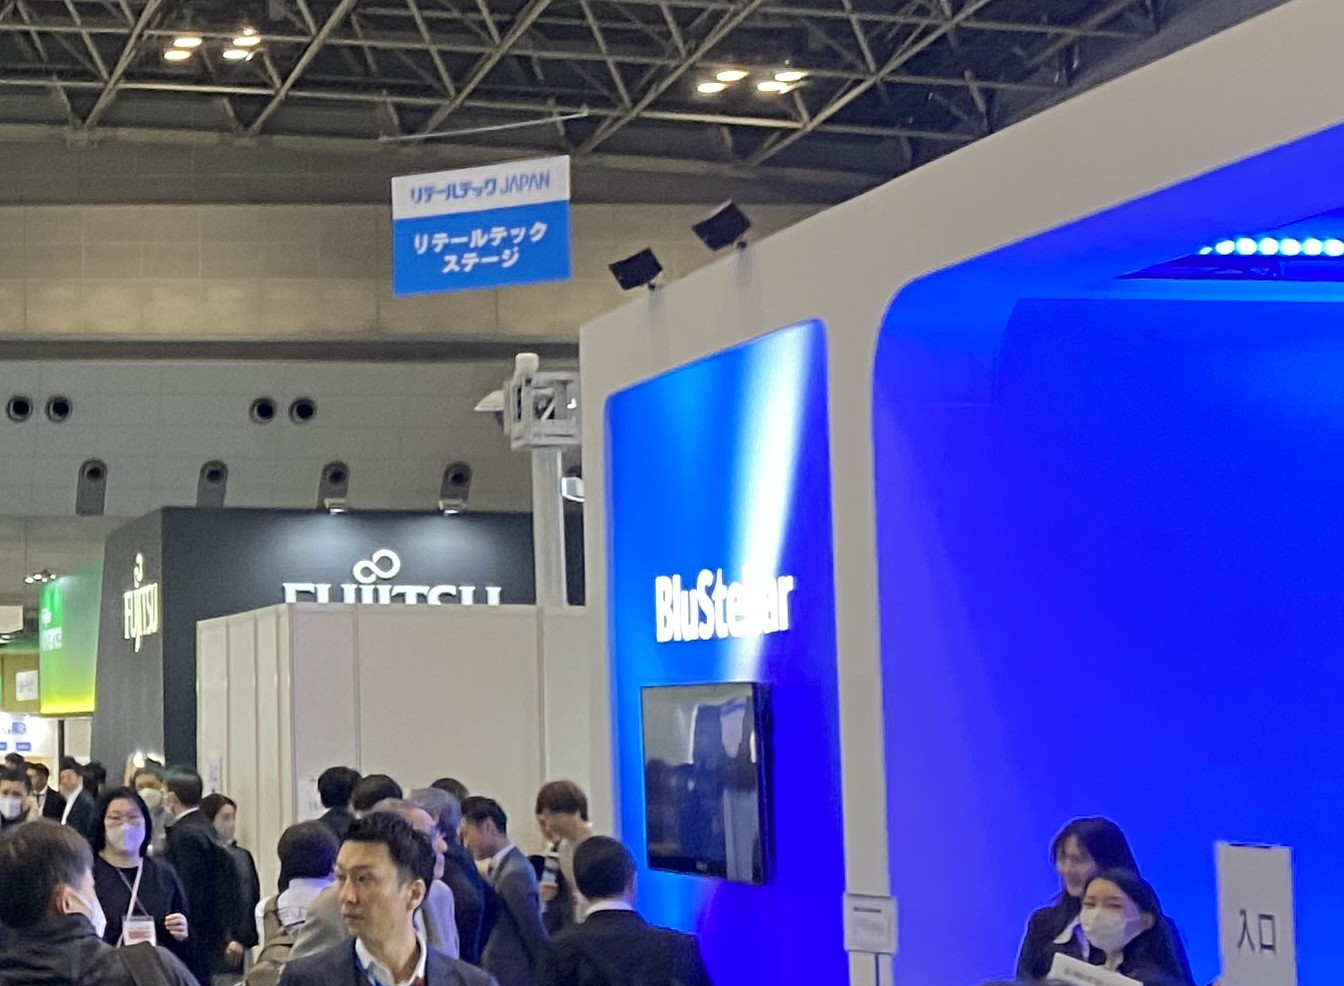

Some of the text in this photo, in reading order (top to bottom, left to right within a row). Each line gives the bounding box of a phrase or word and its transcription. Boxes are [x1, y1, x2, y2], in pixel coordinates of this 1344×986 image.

[411, 171, 550, 203] リテールテック JAPAN
[414, 221, 548, 255] リテールテック
[442, 247, 520, 273] ステージ
[655, 565, 794, 643] BluStear
[1237, 909, 1277, 955] 入口
